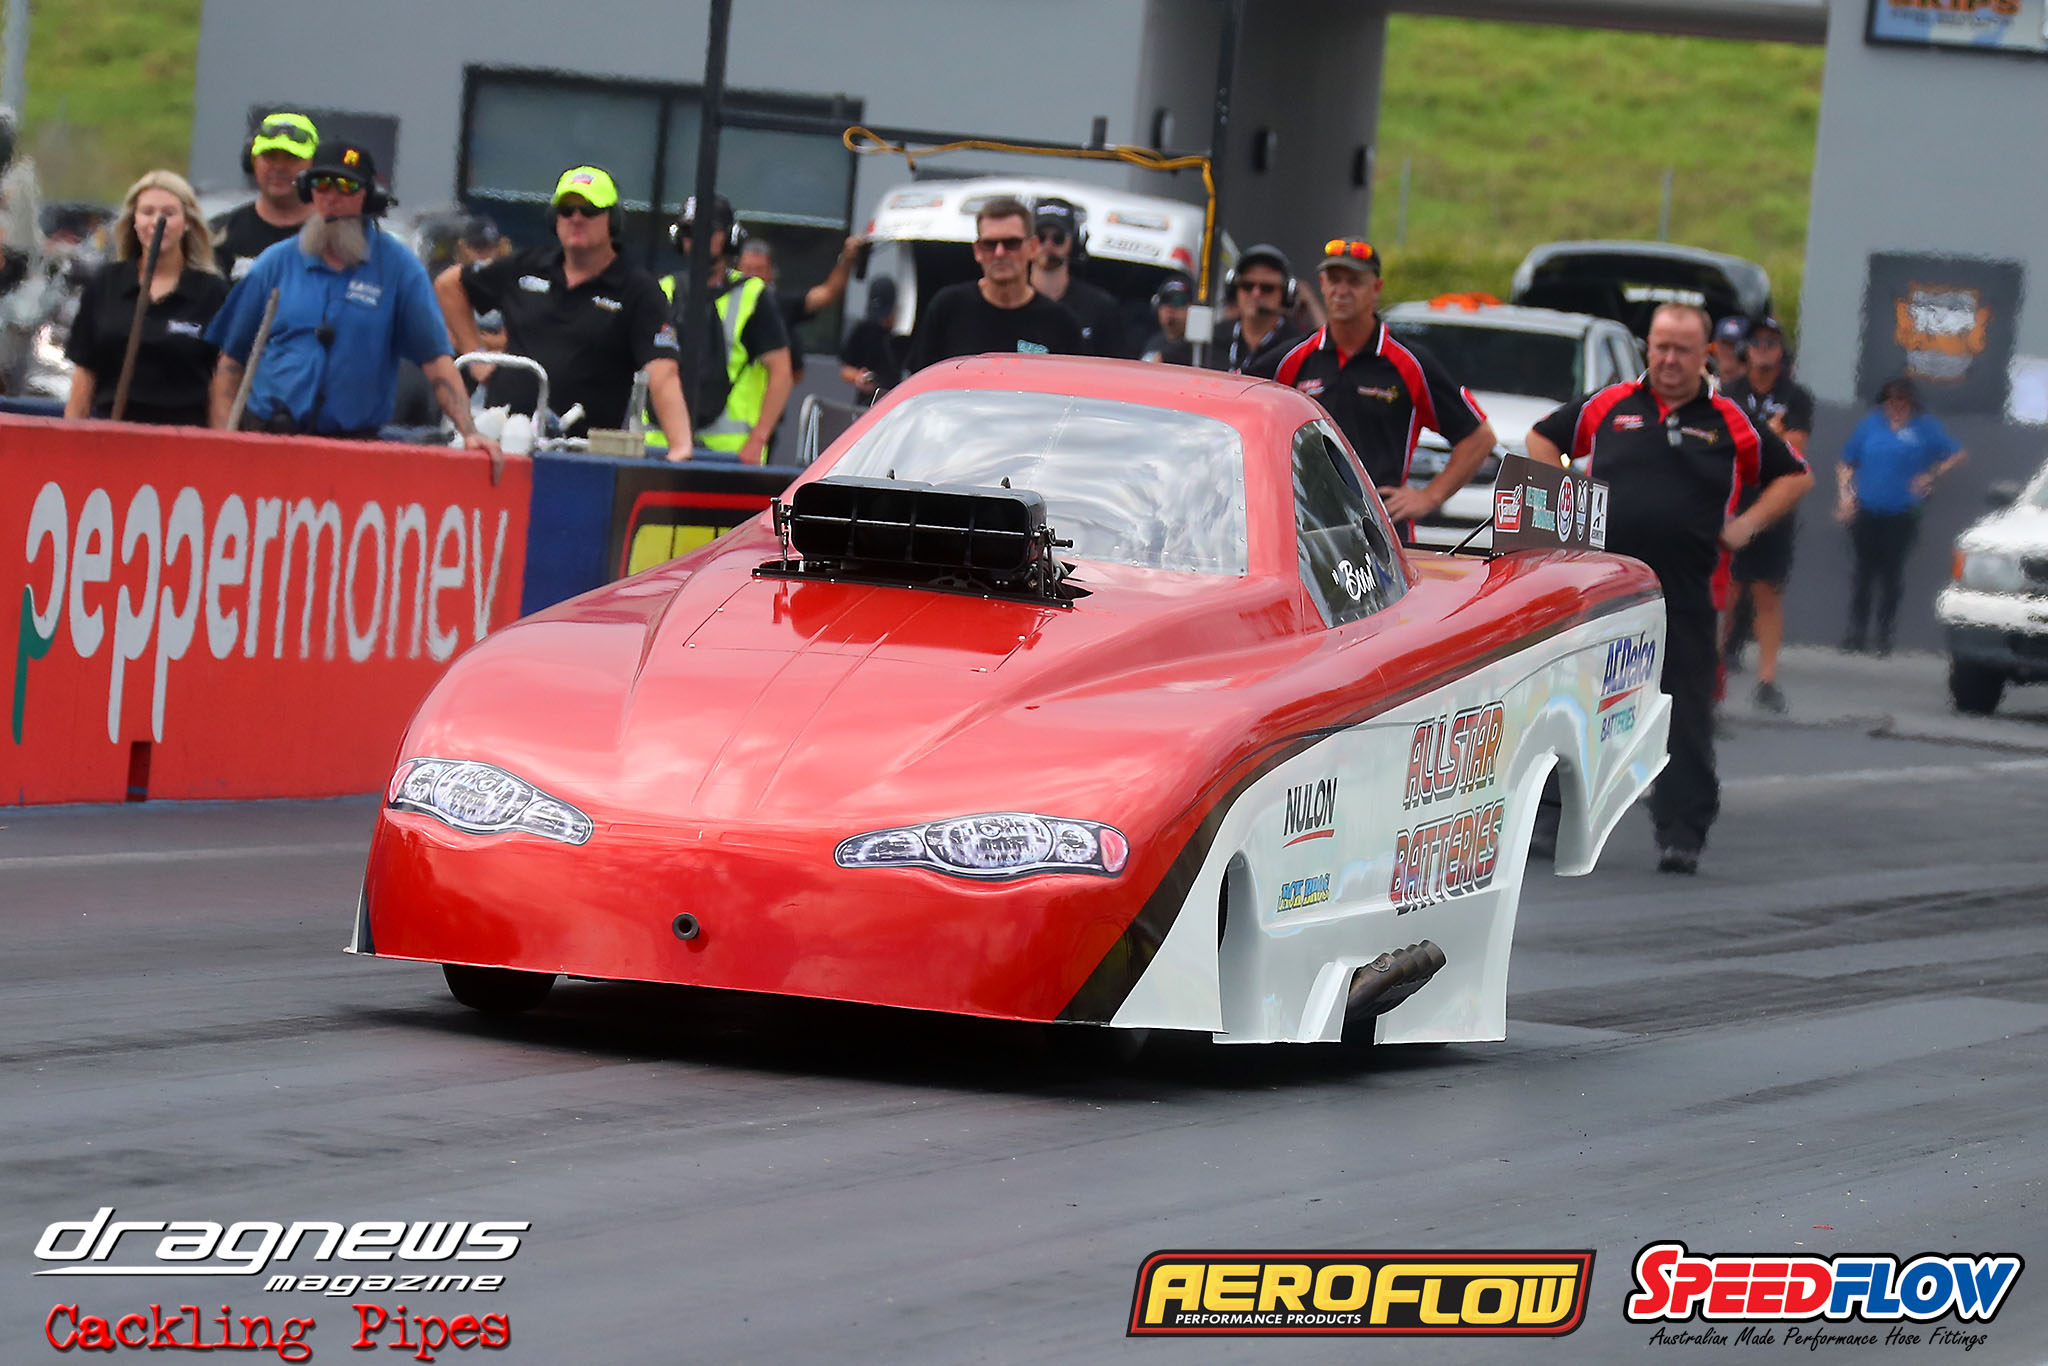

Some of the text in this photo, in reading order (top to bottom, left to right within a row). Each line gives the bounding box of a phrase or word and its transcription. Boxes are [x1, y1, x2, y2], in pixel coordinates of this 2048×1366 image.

[12, 481, 509, 746] peppermoney
[1283, 777, 1338, 837] NULON
[1402, 701, 1505, 811] ALLSTAR
[1389, 798, 1505, 916] BATTERIES
